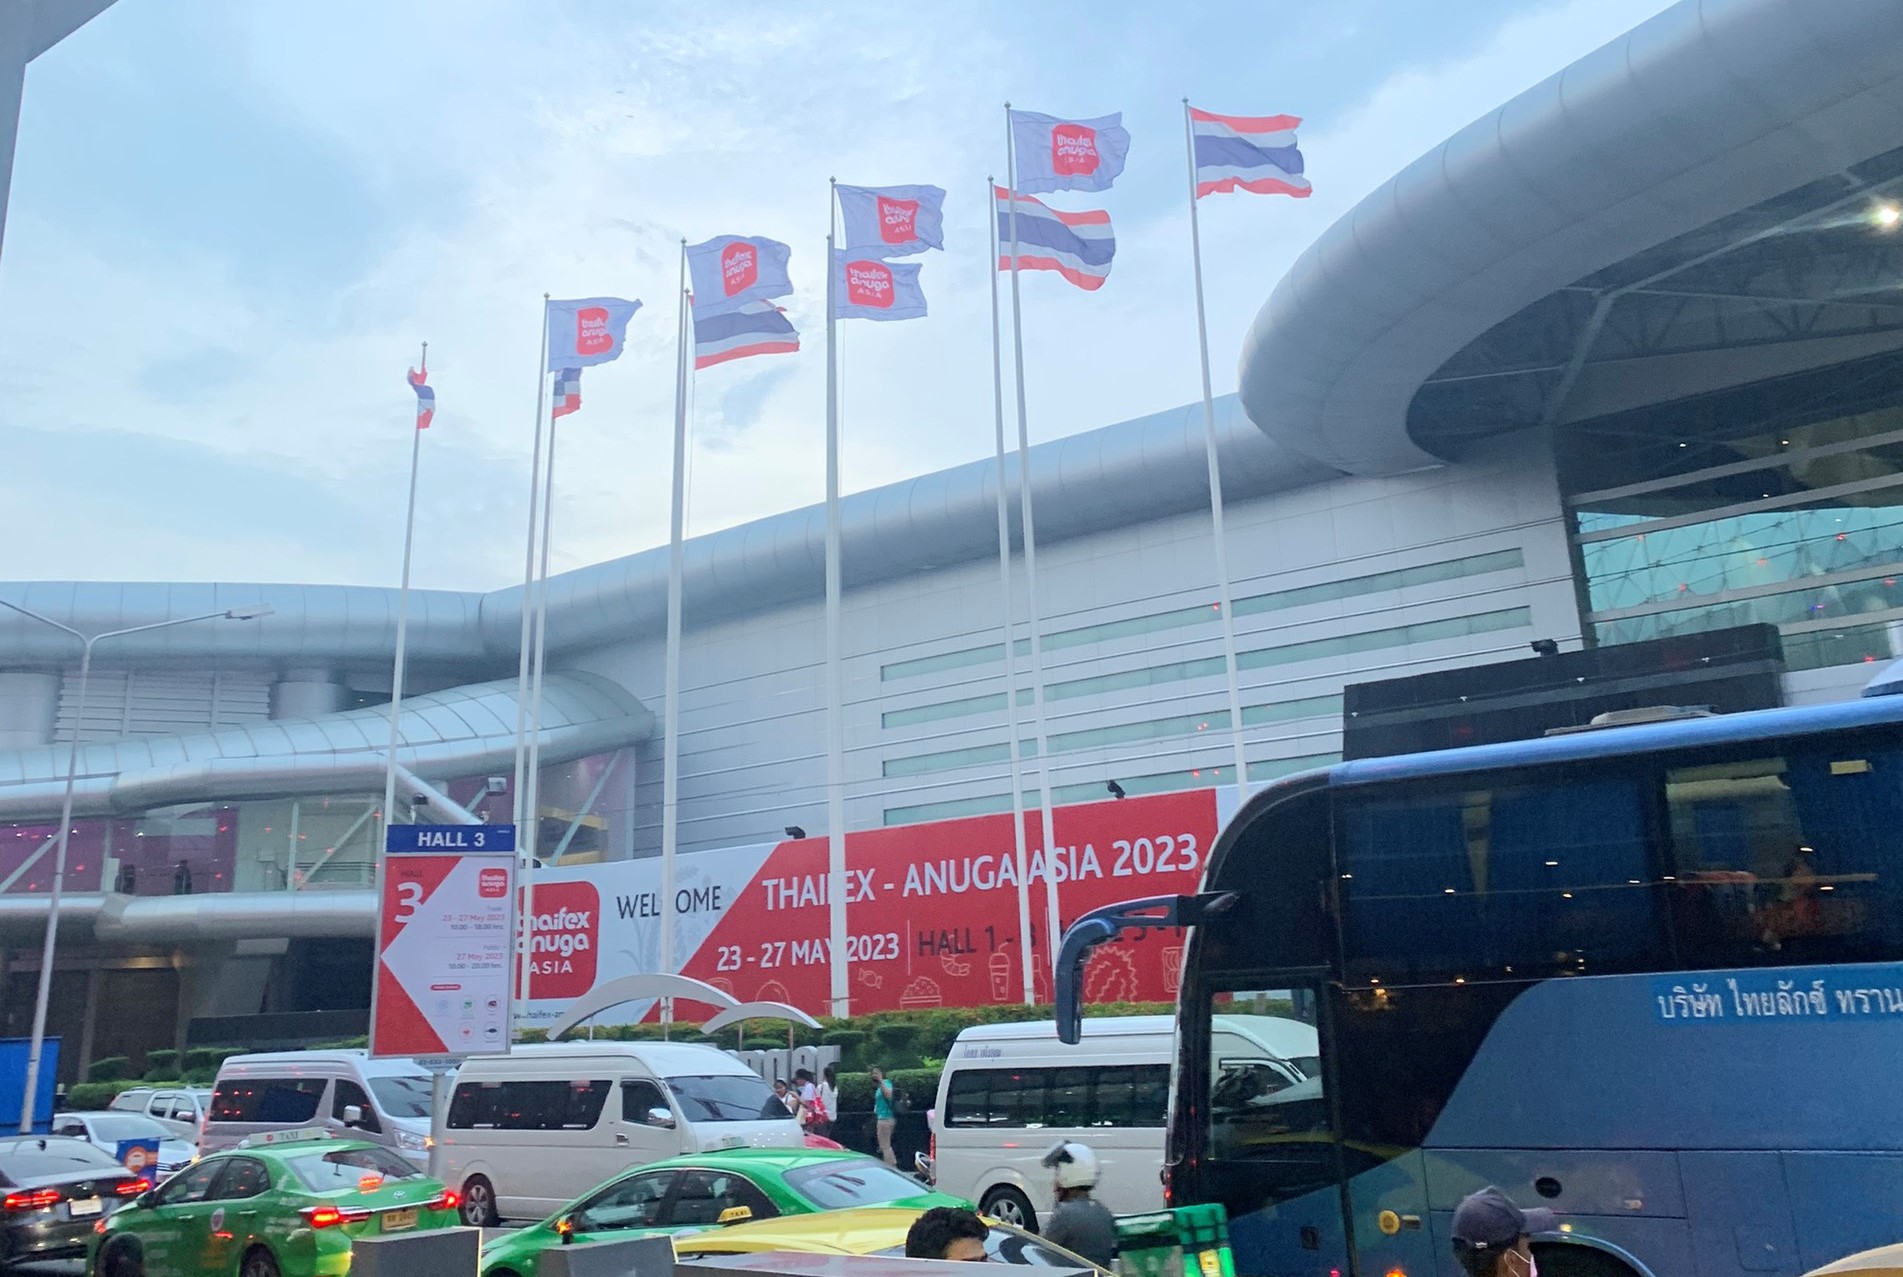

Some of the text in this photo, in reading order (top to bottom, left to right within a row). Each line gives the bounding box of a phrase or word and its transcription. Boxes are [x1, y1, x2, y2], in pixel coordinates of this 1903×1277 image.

[418, 832, 485, 847] HALL 3
[762, 832, 1199, 911] THAIEX - ANUGA ASIA 2023
[394, 881, 424, 924] 3
[470, 914, 485, 923] May
[616, 885, 721, 920] WELOME
[468, 953, 483, 962] May
[716, 945, 742, 972] 23
[760, 941, 786, 969] 27
[846, 932, 901, 963] 2023
[917, 926, 977, 957] HALL
[530, 960, 574, 975] ASIA
[1658, 983, 1724, 1018] บริษัท
